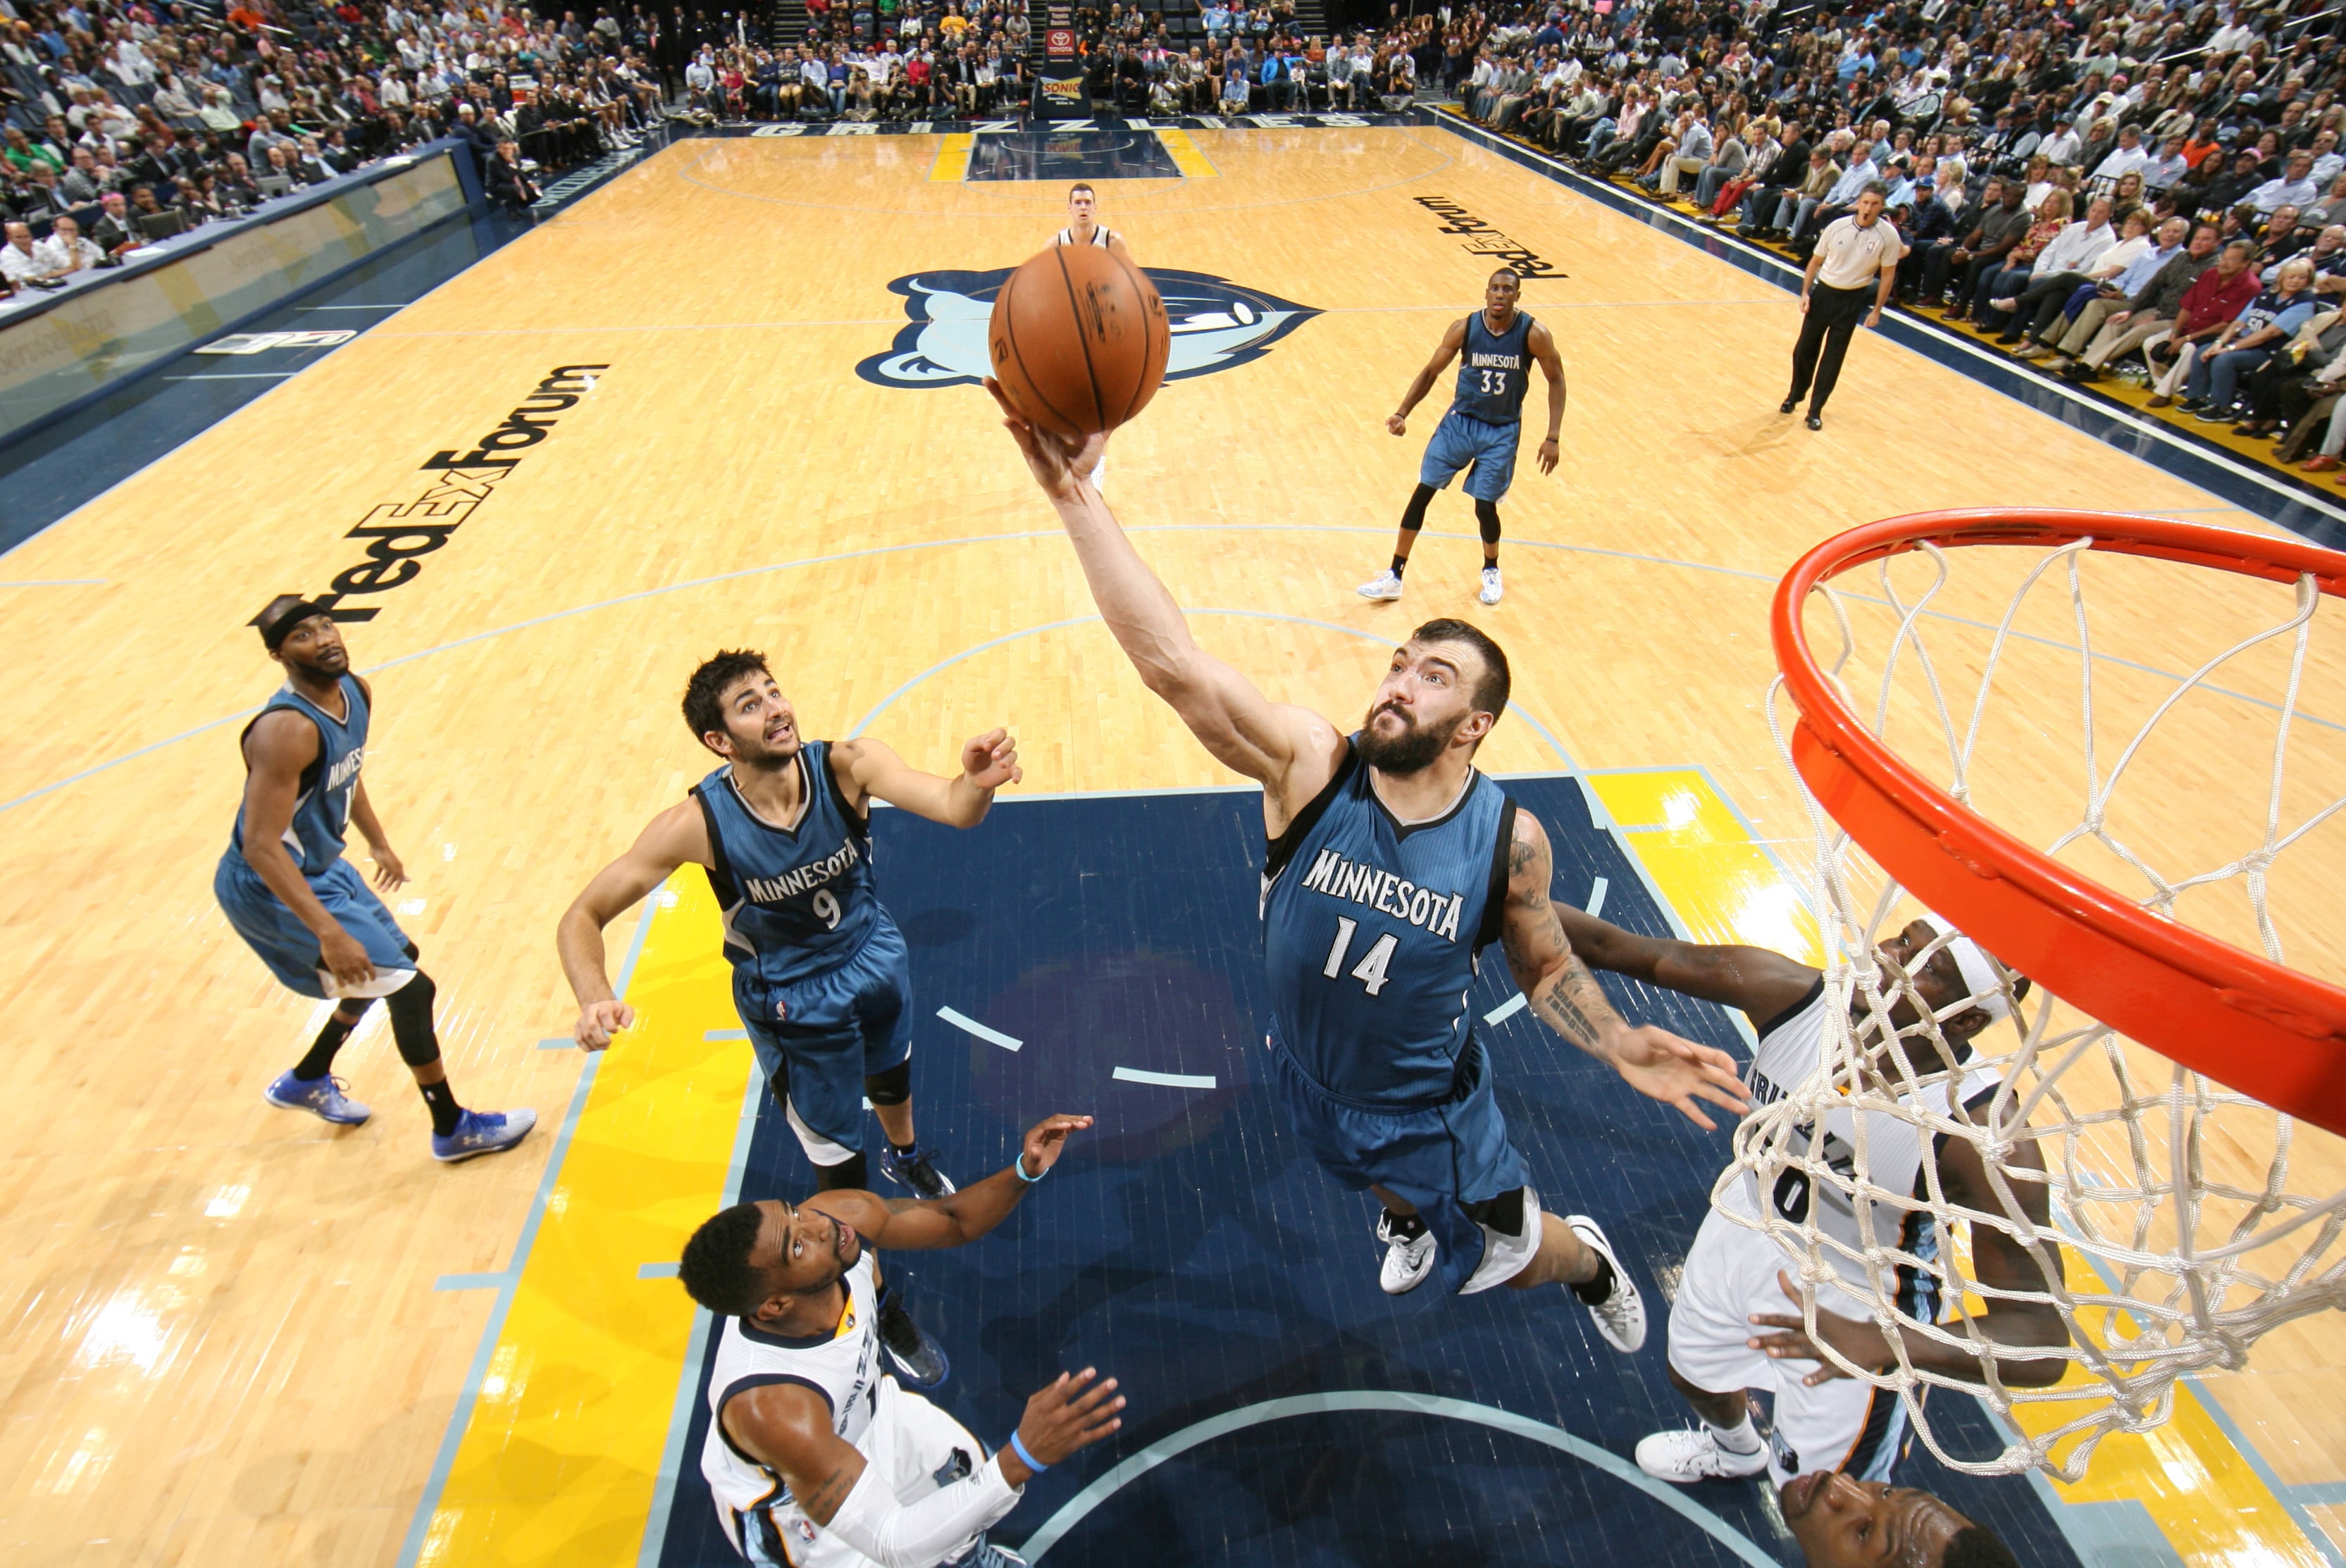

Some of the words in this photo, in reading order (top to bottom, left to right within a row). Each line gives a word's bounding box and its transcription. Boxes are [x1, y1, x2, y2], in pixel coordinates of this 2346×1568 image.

[1043, 82, 1080, 92] SONIC
[750, 115, 1370, 137] GRIZZLIES
[1471, 352, 1520, 370] MINNESOTA
[1480, 369, 1506, 395] 33
[326, 746, 364, 792] MINNES
[745, 836, 858, 903] MINNESOTA
[812, 888, 841, 930] 9
[1301, 848, 1465, 944] MINNESOTA
[1322, 914, 1400, 997] 14
